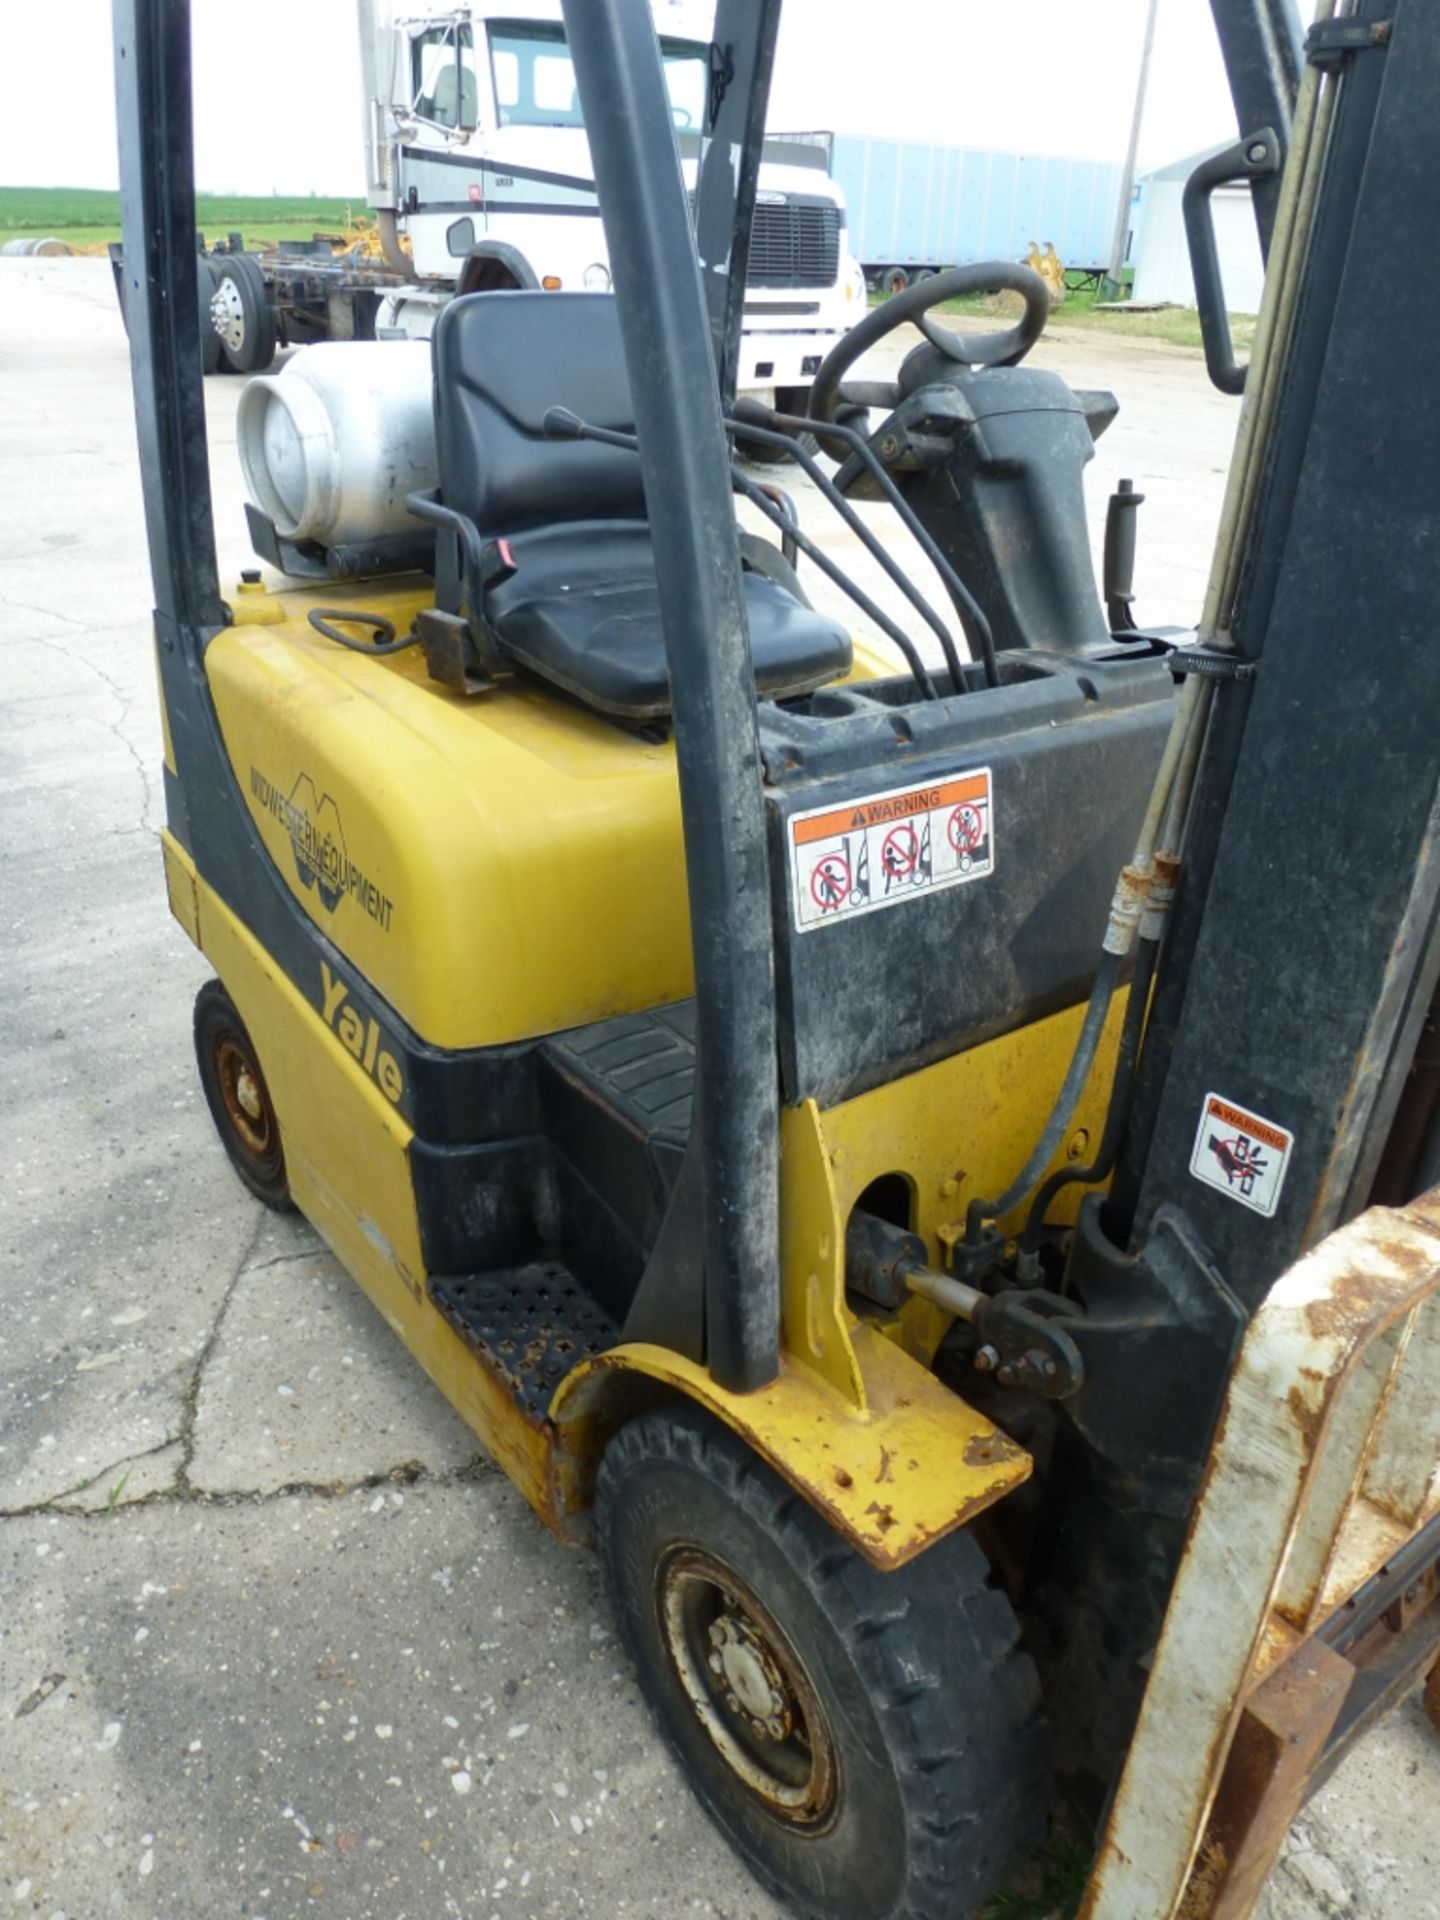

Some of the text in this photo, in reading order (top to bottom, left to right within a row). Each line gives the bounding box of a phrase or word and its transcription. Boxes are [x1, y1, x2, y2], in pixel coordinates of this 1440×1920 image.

[868, 791, 941, 823] WARNING
[320, 836, 394, 932] EQUIPMENT
[320, 960, 402, 1104] Yale
[1223, 1108, 1285, 1148] WARNING
